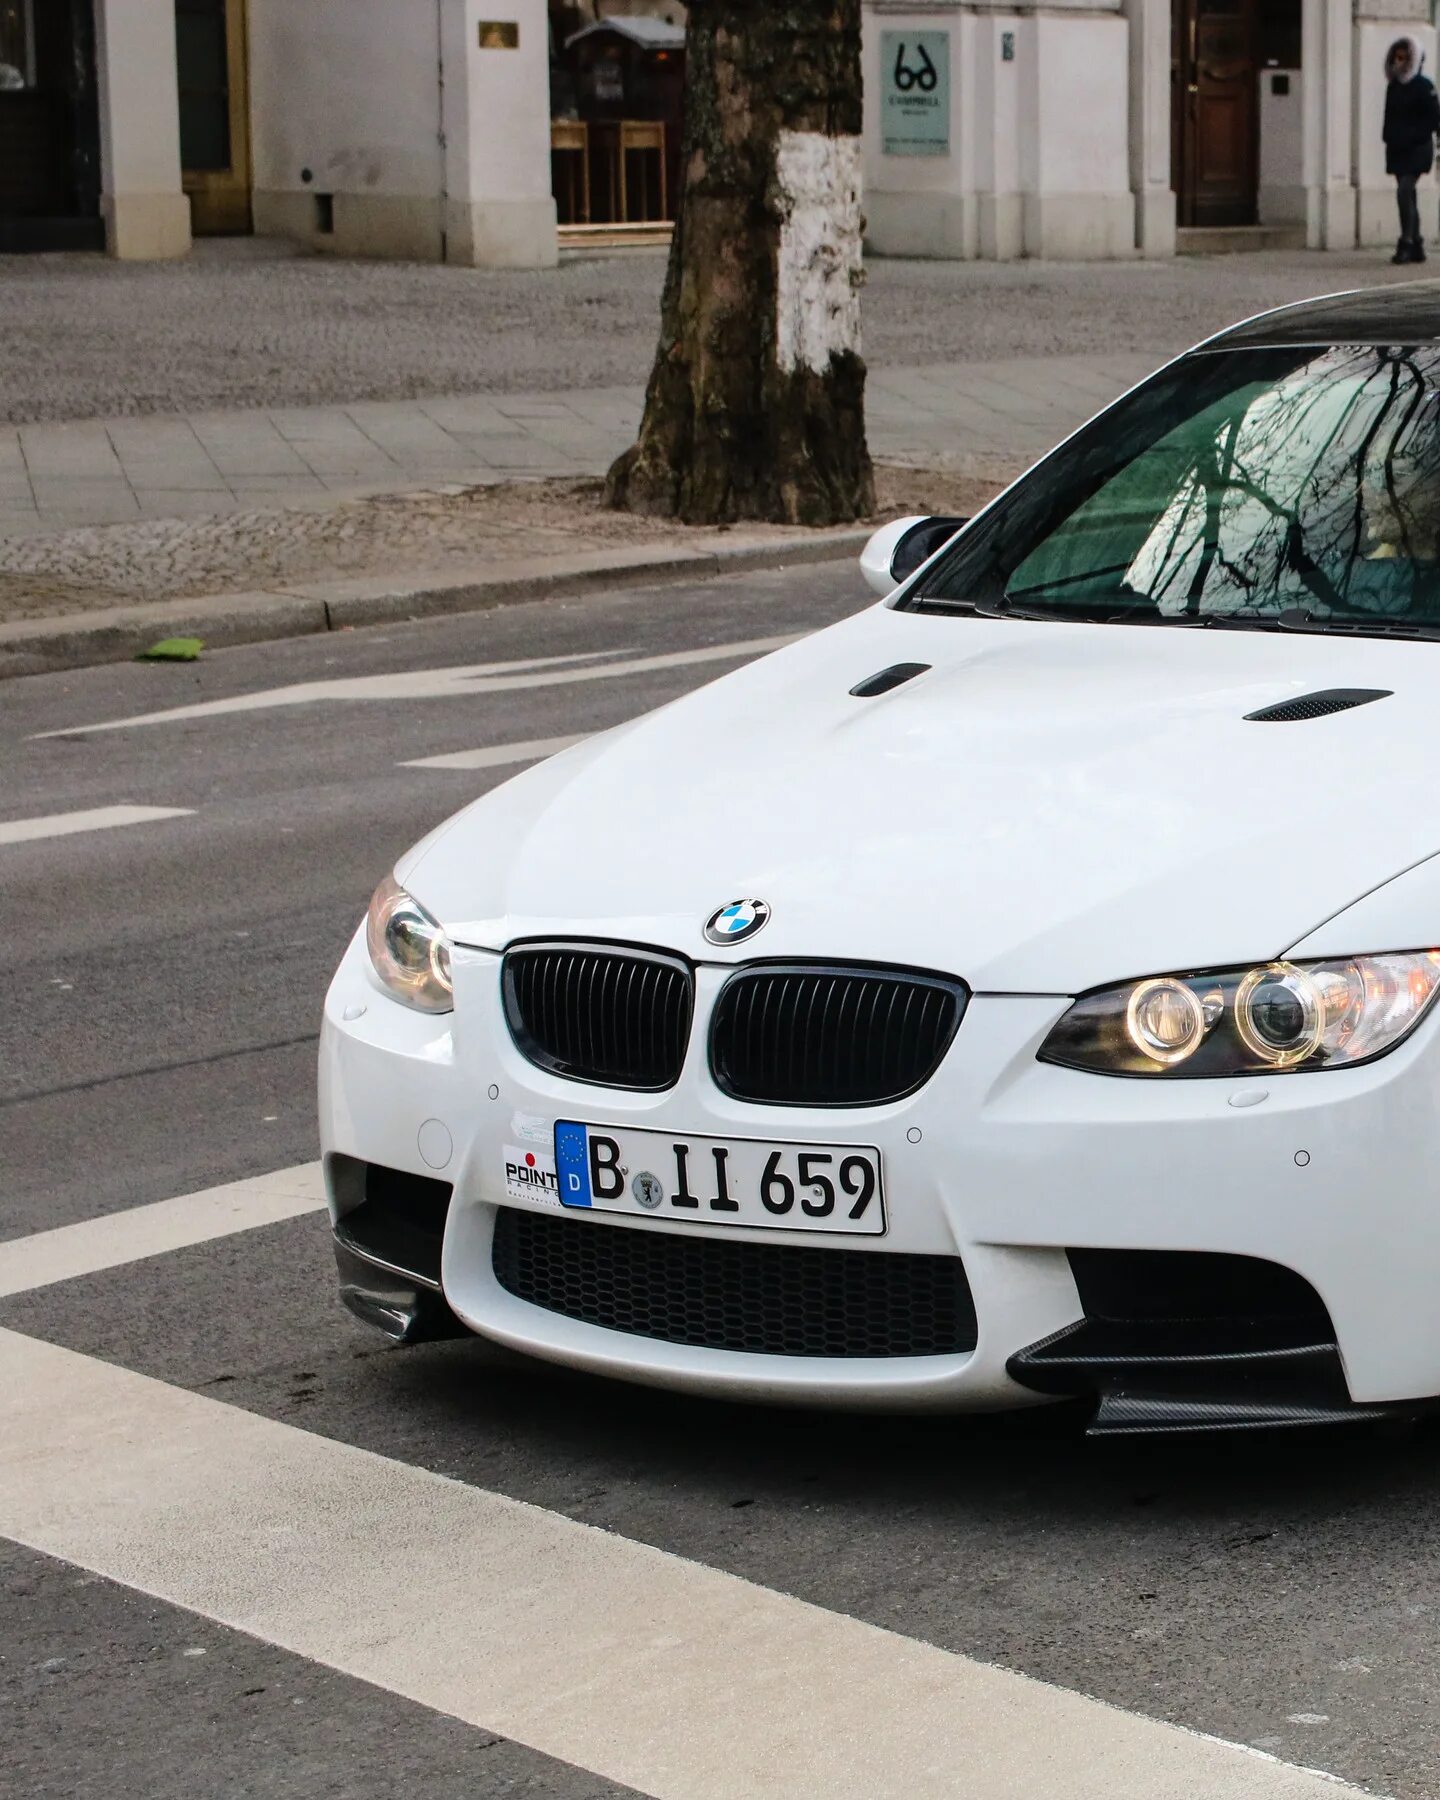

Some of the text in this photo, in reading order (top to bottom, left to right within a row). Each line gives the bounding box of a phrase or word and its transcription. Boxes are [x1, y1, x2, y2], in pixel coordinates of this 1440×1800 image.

[505, 1161, 558, 1188] POINT
[568, 1172, 581, 1191] D
[589, 1135, 625, 1200] B
[671, 1143, 740, 1212] II
[760, 1151, 876, 1220] 659
